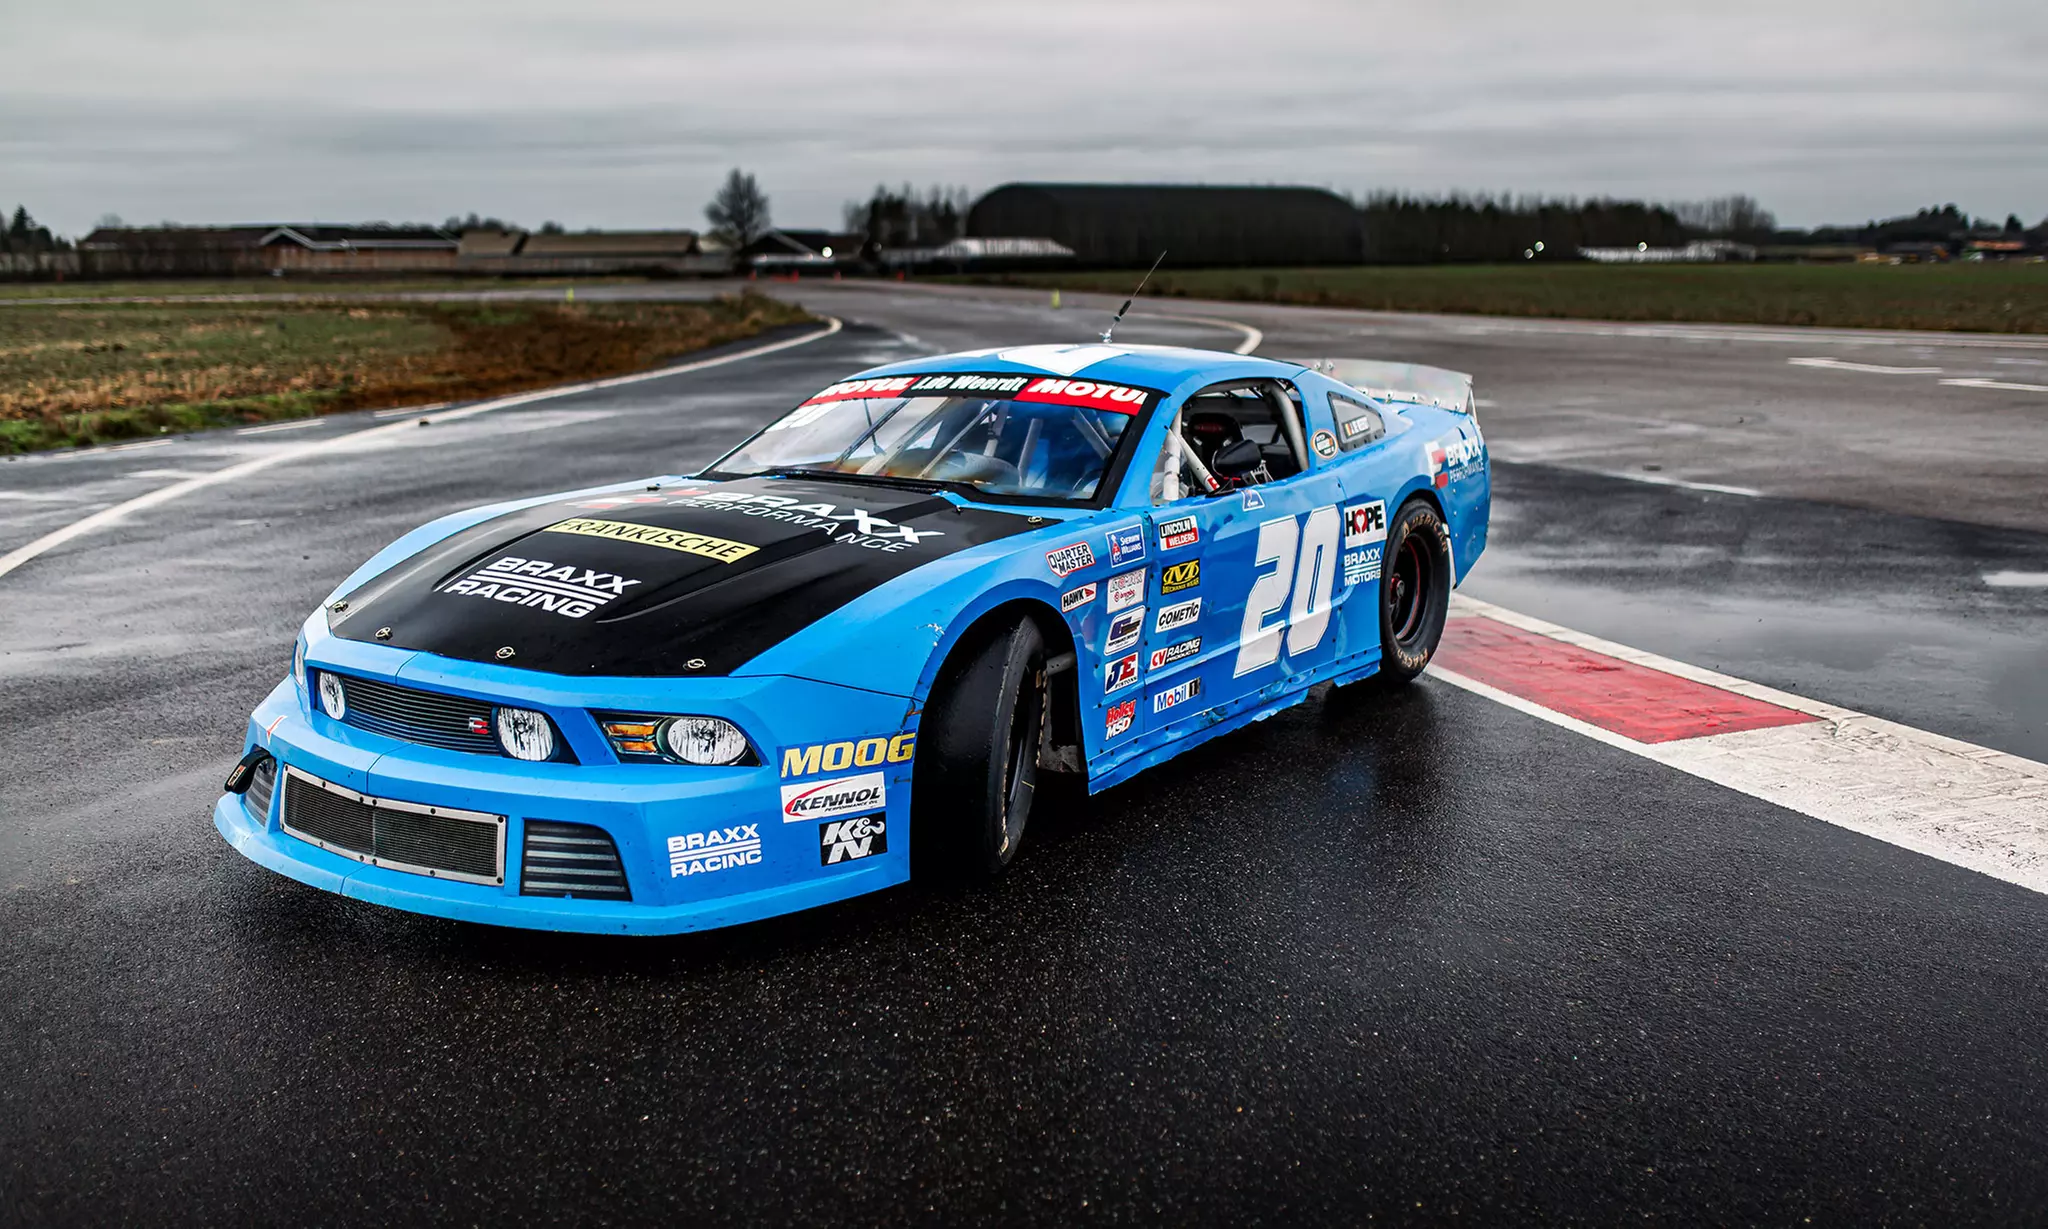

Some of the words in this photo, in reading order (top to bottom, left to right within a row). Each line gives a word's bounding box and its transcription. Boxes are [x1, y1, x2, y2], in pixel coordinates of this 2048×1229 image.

[667, 498, 912, 553] PERFORMANCE
[693, 492, 945, 543] BRAXX
[1160, 520, 1192, 536] LINCOLN
[1344, 505, 1384, 537] HOPE
[1169, 532, 1196, 547] WELDERS
[1047, 543, 1089, 569] QUARTER
[1059, 553, 1093, 574] MASTER
[1344, 547, 1380, 567] BRAXX
[486, 557, 642, 594] BRAXX
[444, 580, 596, 618] RACING
[1063, 588, 1084, 607] HAWK
[1233, 504, 1341, 679] 20
[1152, 650, 1166, 666] CV
[1166, 638, 1201, 657] RACING
[1157, 685, 1187, 711] Mobil
[1106, 716, 1131, 740] MSD
[780, 732, 917, 778] MOOG
[792, 787, 880, 812] KENNOL
[667, 823, 760, 853] BRAXX
[671, 849, 762, 878] RACING
